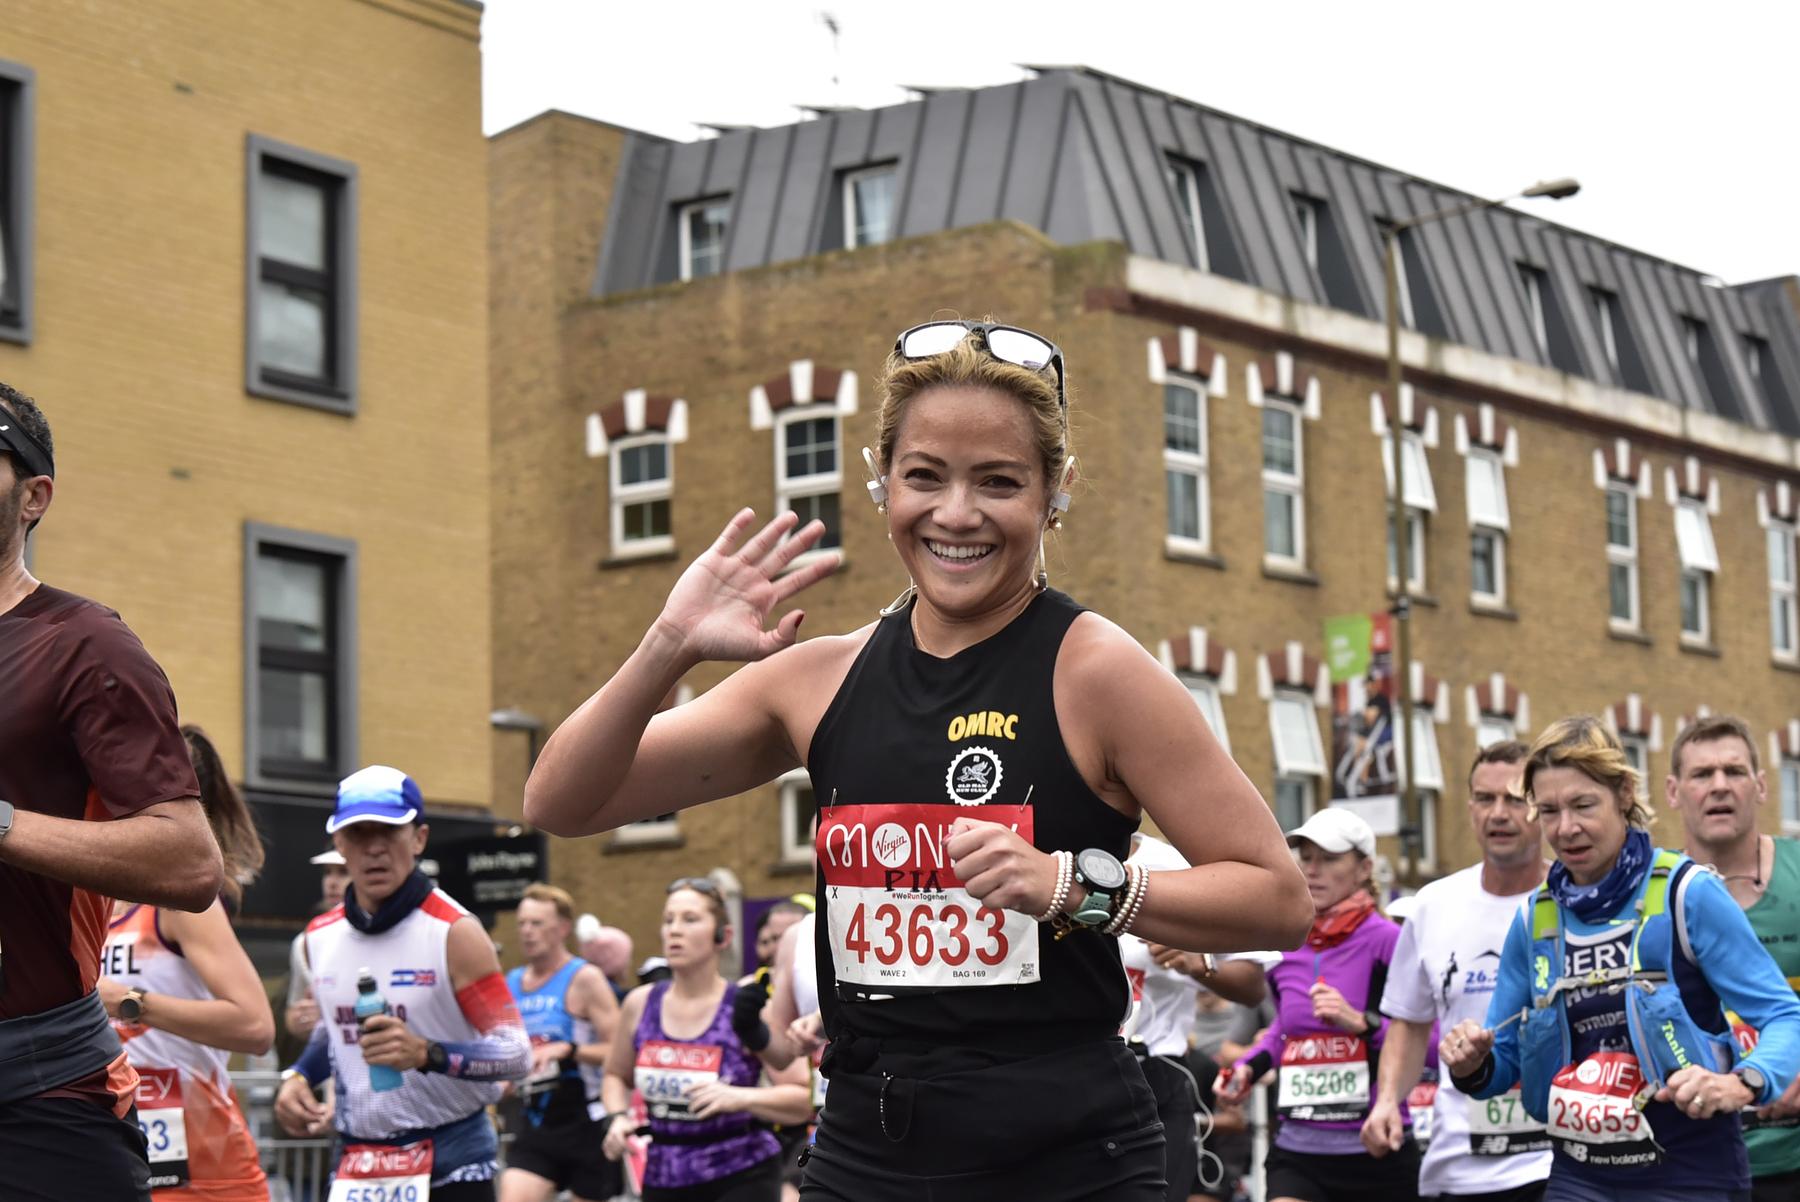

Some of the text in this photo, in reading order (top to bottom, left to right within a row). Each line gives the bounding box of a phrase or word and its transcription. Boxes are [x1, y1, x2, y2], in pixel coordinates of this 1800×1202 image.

[947, 710, 1019, 742] OMRC
[875, 829, 908, 861] Virgin
[884, 869, 945, 893] PIA
[891, 891, 948, 902] #WeRunTogether
[845, 902, 1009, 967] 43633
[880, 969, 900, 977] WAVE
[952, 969, 987, 978] BAG 169
[1291, 1071, 1357, 1097] 55208
[1553, 1097, 1640, 1134] 23655
